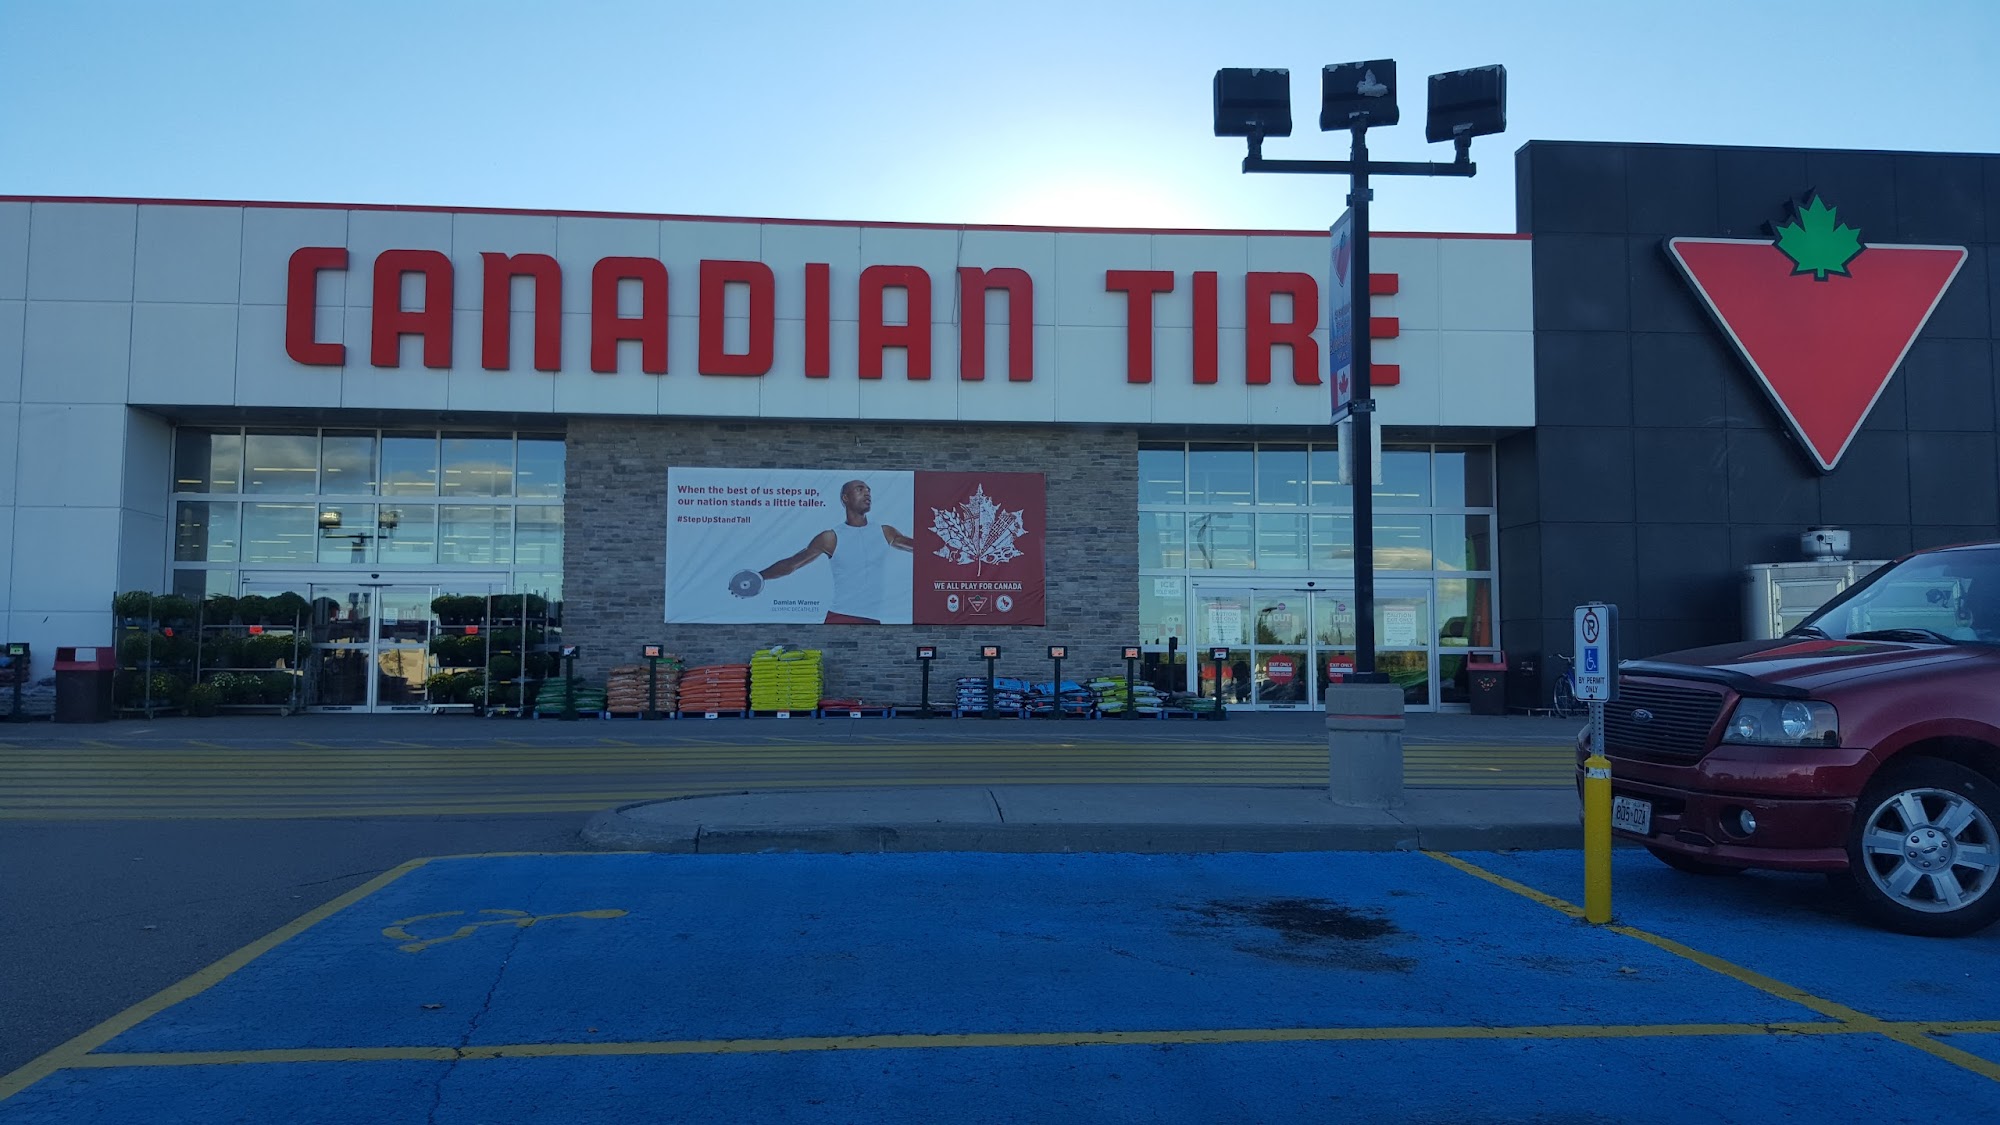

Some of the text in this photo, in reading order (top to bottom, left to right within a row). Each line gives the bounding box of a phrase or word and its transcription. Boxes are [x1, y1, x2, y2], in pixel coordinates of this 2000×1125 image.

[285, 246, 1400, 386] CANADIAN TIRE
[677, 485, 705, 494] When
[708, 485, 724, 494] the
[727, 486, 748, 495] best
[751, 486, 761, 495] of
[777, 487, 802, 497] steps
[805, 489, 820, 497] up,
[697, 497, 728, 506] nation
[731, 498, 762, 507] stands
[773, 498, 796, 507] little
[799, 498, 826, 507] taller.
[677, 515, 751, 524] #StepUpStandTall
[934, 582, 1022, 590] WE ALL PLAY FOR CANADA
[1273, 613, 1291, 622] OUT
[1578, 676, 1605, 685] BY PERMIT
[1585, 685, 1599, 693] ONLY
